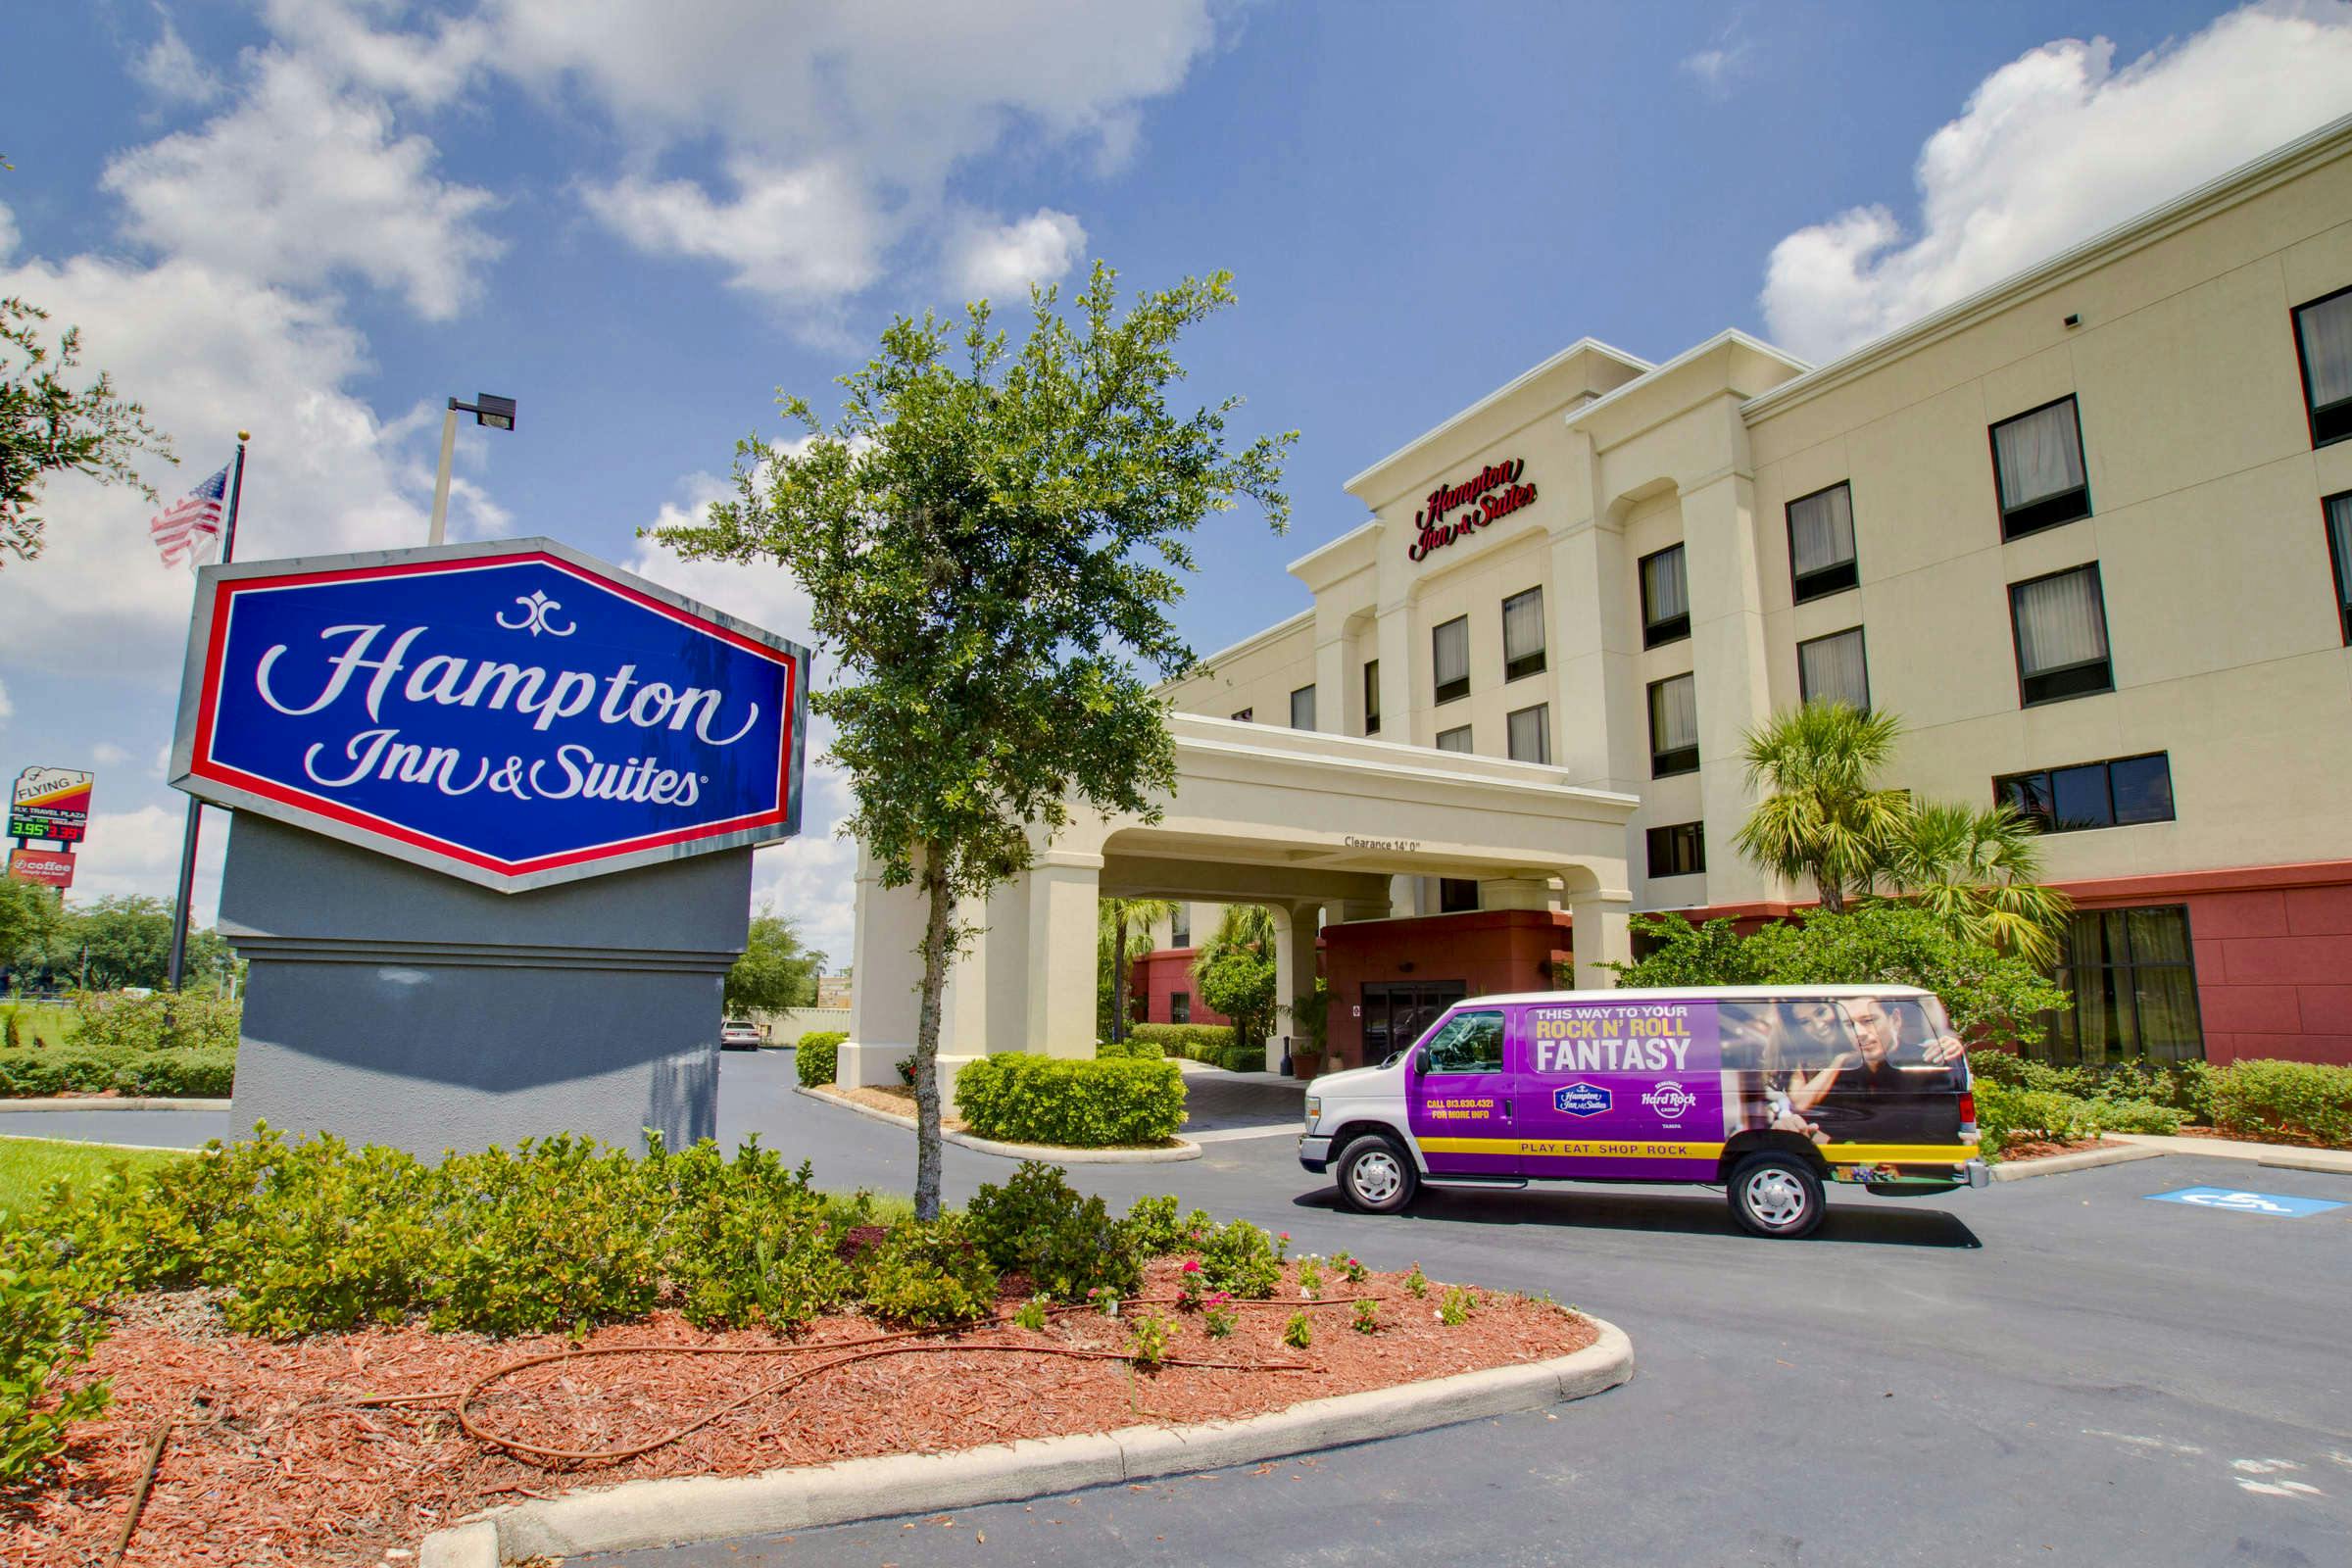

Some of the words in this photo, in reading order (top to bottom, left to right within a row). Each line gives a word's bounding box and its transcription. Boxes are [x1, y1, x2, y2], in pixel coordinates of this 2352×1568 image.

[1415, 458, 1524, 530] Hampton
[1408, 524, 1458, 562] Inn
[1457, 514, 1475, 534] &
[1472, 483, 1538, 527] Suites
[256, 624, 760, 745] Hampton
[304, 728, 490, 795] Inn
[490, 756, 533, 801] &
[18, 777, 70, 800] FLYING
[76, 772, 85, 784] J
[30, 808, 59, 816] TRAVEL
[61, 810, 86, 819] PLAZA
[1345, 836, 1392, 850] Clearance
[1394, 841, 1408, 852] 14'
[27, 861, 72, 872] coffee
[1536, 1009, 1572, 1020] THIS
[1576, 1008, 1613, 1019] WAY
[1617, 1007, 1638, 1018] TO
[1642, 1005, 1688, 1017] YOUR
[1536, 1020, 1597, 1039] ROCK
[1602, 1018, 1624, 1037] N'
[1630, 1018, 1691, 1037] ROLL
[1537, 1038, 1691, 1071] FANTASY
[1427, 1100, 1445, 1108] CALL
[1561, 1092, 1601, 1102] Hampton
[1642, 1093, 1669, 1104] Hard
[1669, 1093, 1696, 1106] Rock
[1432, 1110, 1447, 1119] FOR
[1448, 1110, 1470, 1119] MORE
[1471, 1110, 1490, 1119] INFO
